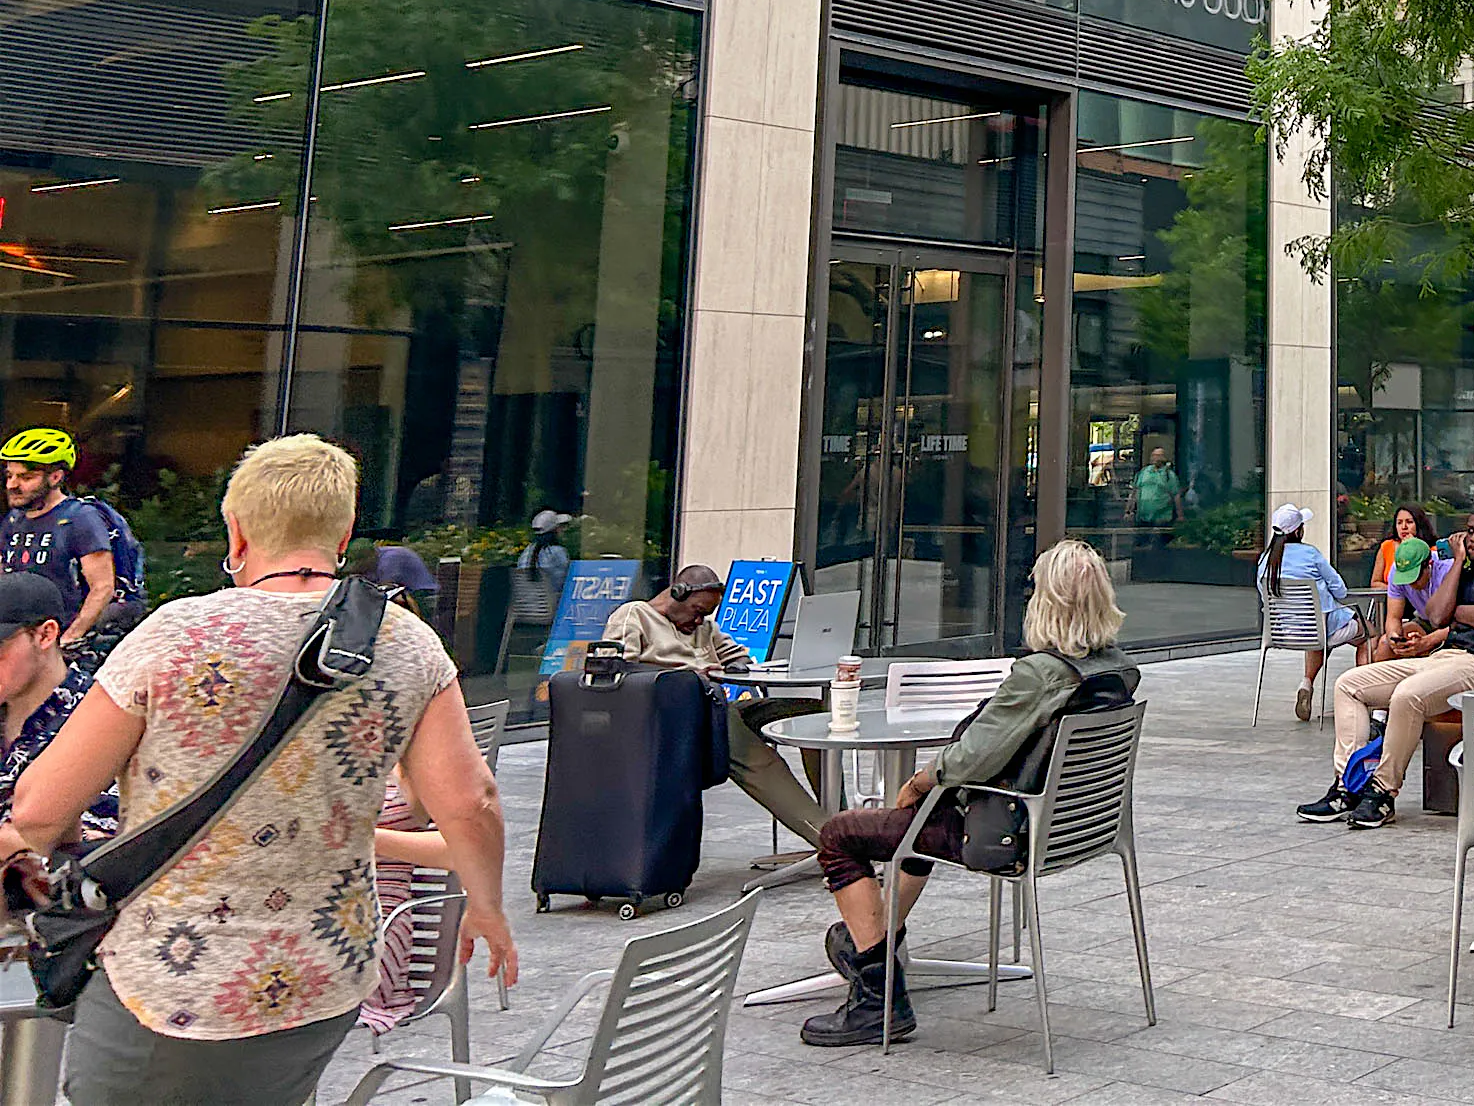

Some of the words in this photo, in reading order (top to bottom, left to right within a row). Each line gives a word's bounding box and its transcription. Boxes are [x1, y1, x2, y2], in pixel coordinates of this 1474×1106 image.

[9, 533, 53, 547] SEE
[728, 578, 783, 605] EAST
[720, 606, 769, 633] PLAZA
